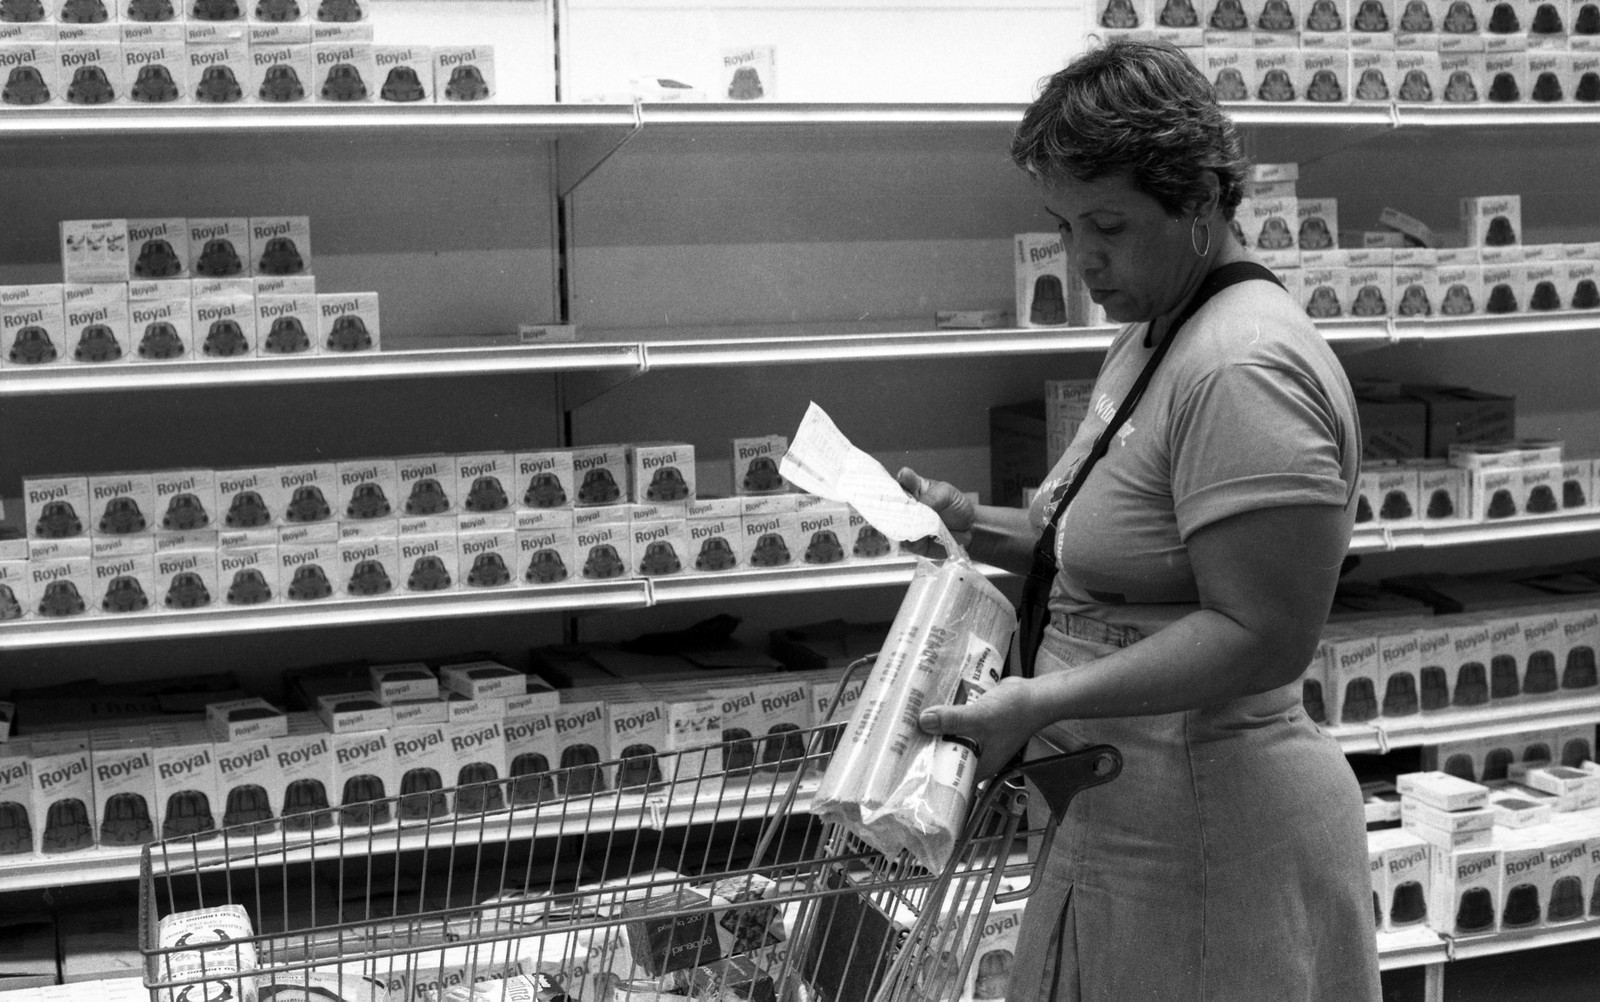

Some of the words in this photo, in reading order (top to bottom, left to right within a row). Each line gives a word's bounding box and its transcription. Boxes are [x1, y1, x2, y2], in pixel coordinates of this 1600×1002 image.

[61, 49, 100, 67] Royal
[125, 48, 165, 66] Royal
[190, 49, 229, 66] Royal
[254, 48, 292, 66] Royal
[317, 47, 355, 65] Royal
[375, 49, 412, 66] Royal
[440, 48, 476, 66] Royal
[724, 50, 754, 67] Royal
[130, 223, 167, 241] Royal
[192, 223, 229, 240] Royal
[254, 222, 291, 239] Royal
[1030, 240, 1064, 263] Royal
[66, 287, 93, 300] Royal
[131, 284, 158, 297] Royal
[258, 280, 284, 292] Royal
[2, 289, 29, 302] Royal
[69, 308, 108, 326] Royal
[133, 306, 171, 323] Royal
[198, 305, 236, 321] Royal
[260, 301, 297, 319] Royal
[322, 299, 359, 317] Royal
[3, 310, 43, 328] Royal
[739, 442, 772, 460] Royal
[461, 461, 497, 479] Royal
[520, 457, 555, 475] Royal
[573, 453, 608, 471] Royal
[642, 452, 677, 470] Royal
[281, 470, 317, 488] Royal
[342, 467, 378, 486] Royal
[401, 464, 437, 482] Royal
[94, 481, 132, 499] Royal
[157, 477, 195, 496] Royal
[220, 475, 258, 493] Royal
[30, 485, 68, 503] Royal
[576, 512, 600, 524] Royal
[633, 507, 657, 520] Royal
[689, 504, 712, 516] Royal
[402, 521, 427, 533] Royal
[460, 518, 485, 530] Royal
[519, 515, 542, 526] Royal
[746, 518, 780, 536] Royal
[801, 516, 833, 532] Royal
[282, 529, 308, 541] Royal
[577, 529, 612, 547] Royal
[635, 525, 669, 543] Royal
[691, 522, 725, 539] Royal
[95, 540, 122, 552] Royal
[158, 536, 184, 549] Royal
[222, 534, 247, 546] Royal
[462, 537, 498, 555] Royal
[521, 533, 556, 551] Royal
[282, 549, 319, 567] Royal
[342, 545, 379, 563] Royal
[402, 541, 438, 559] Royal
[96, 560, 134, 578] Royal
[159, 556, 197, 574] Royal
[221, 552, 258, 571] Royal
[32, 564, 71, 583] Royal
[1525, 619, 1559, 641] Royal
[1564, 614, 1598, 637] Royal
[1455, 629, 1489, 653] Royal
[1341, 643, 1376, 668] Royal
[1383, 639, 1418, 662] Royal
[385, 684, 410, 697] Royal
[478, 680, 501, 693] Royal
[453, 703, 478, 715] Royal
[508, 698, 532, 710] Royal
[722, 692, 756, 714] oyal
[761, 687, 806, 714] Royal
[339, 715, 364, 727] Royal
[504, 715, 551, 742] Royal
[555, 707, 601, 733] Royal
[614, 707, 660, 735] Royal
[394, 729, 444, 757] Royal
[451, 724, 500, 752] Royal
[277, 738, 328, 768] Royal
[336, 736, 387, 764] Royal
[97, 752, 150, 781] Royal
[159, 750, 211, 779] Royal
[219, 745, 270, 774] Royal
[38, 757, 88, 790] Royal
[1389, 848, 1427, 873] Royal
[1506, 851, 1545, 876] Royal
[1550, 843, 1587, 868] Royal
[1458, 855, 1496, 879] Royal
[979, 913, 1018, 939] oyal
